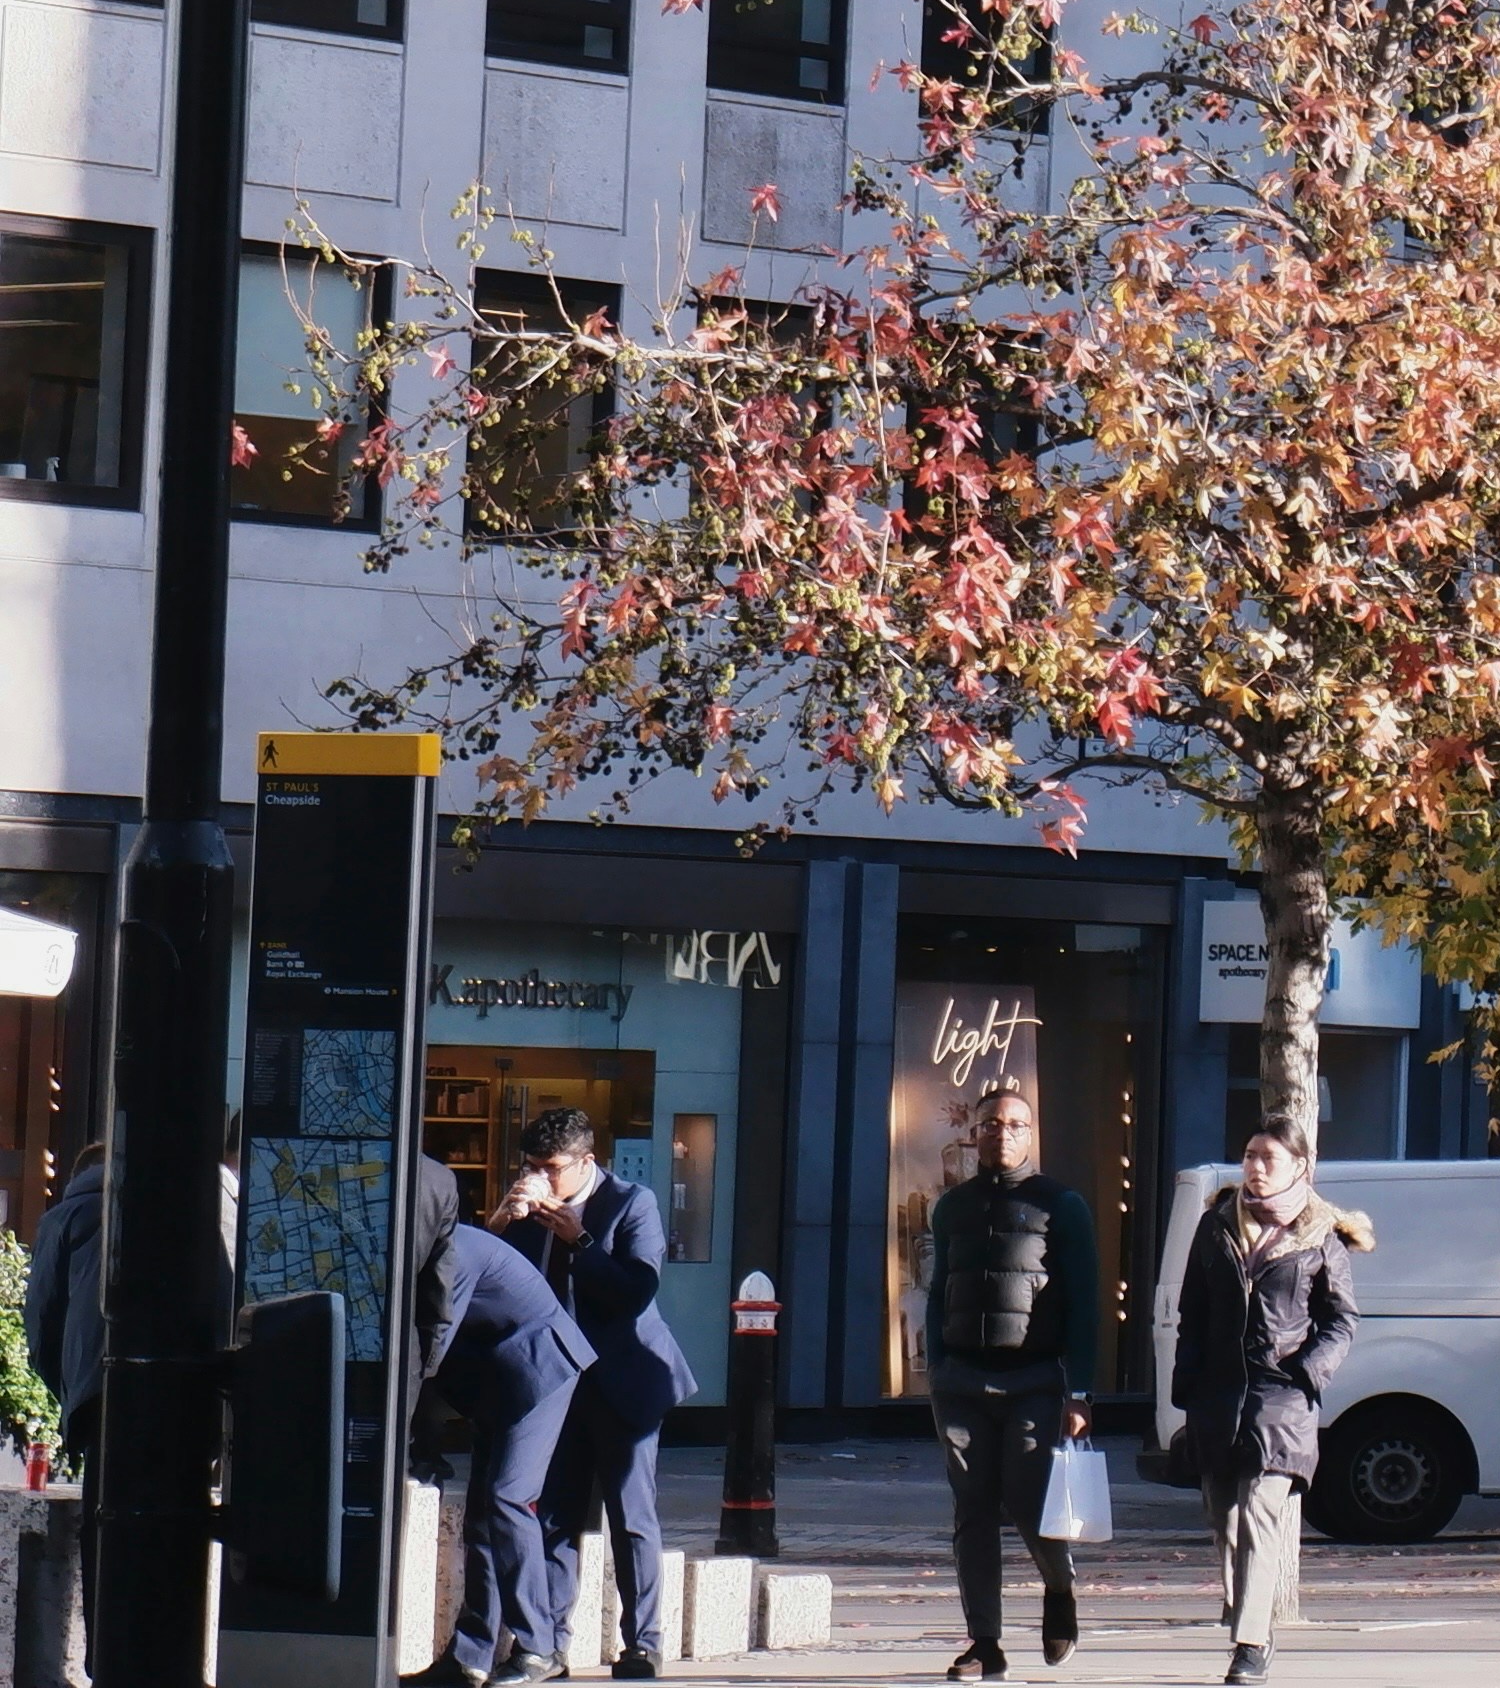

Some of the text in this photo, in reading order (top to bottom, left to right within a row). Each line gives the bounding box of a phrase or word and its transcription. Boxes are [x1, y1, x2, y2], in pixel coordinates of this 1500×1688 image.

[266, 782, 319, 793] ST PAUL'S
[265, 794, 321, 807] Cheapside
[1208, 944, 1270, 961] SPACE.N
[287, 970, 322, 980] Exchange
[1218, 965, 1267, 980] apothecary
[933, 998, 1044, 1087] light
